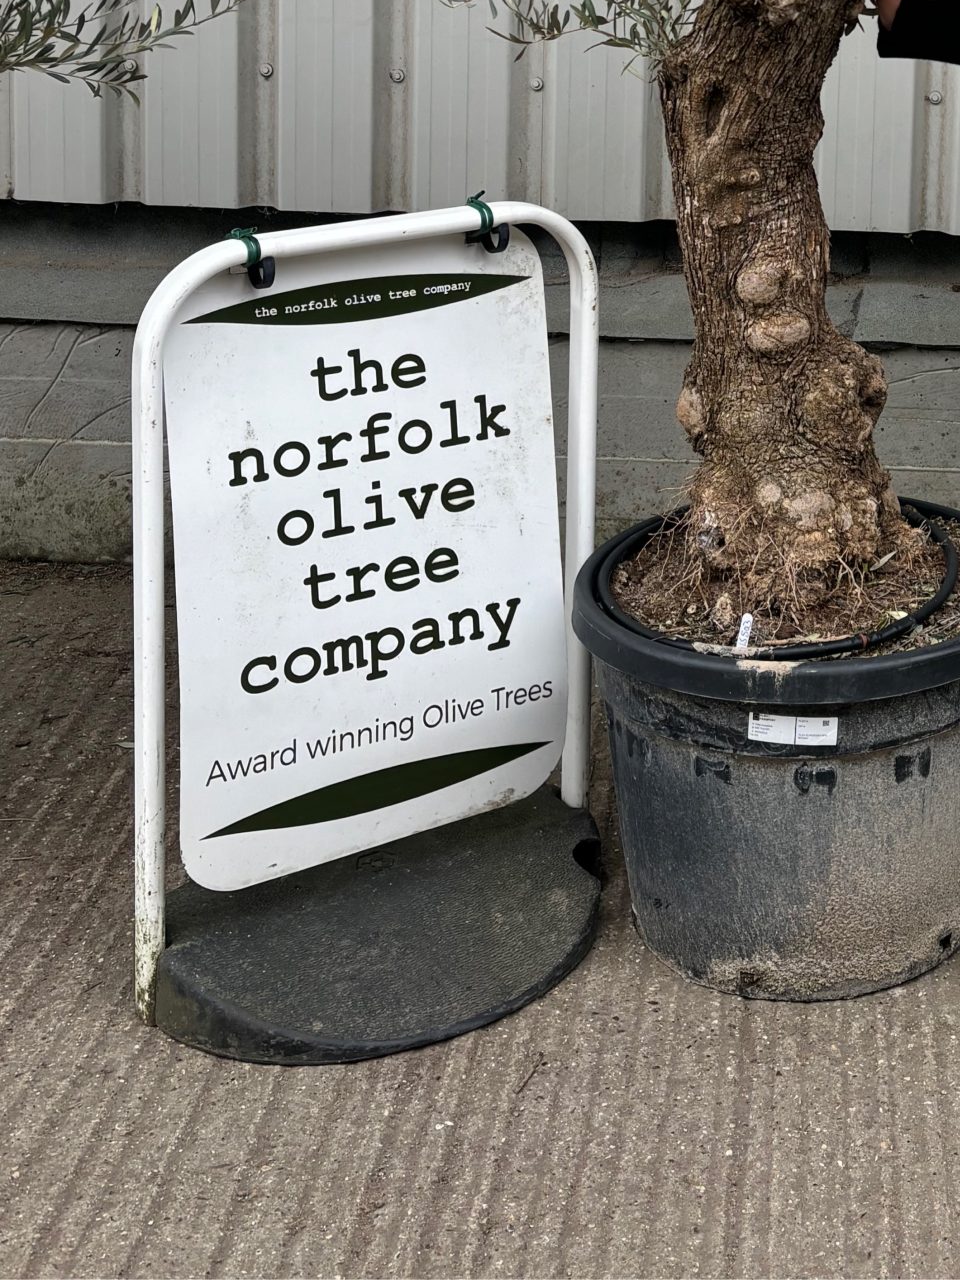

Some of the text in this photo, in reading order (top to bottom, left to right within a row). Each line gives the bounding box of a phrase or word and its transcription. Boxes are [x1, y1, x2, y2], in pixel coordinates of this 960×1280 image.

[254, 281, 472, 318] the norfolk olive tree company
[310, 348, 427, 402] the
[227, 394, 511, 487] norfolk
[276, 477, 476, 547] olive
[303, 547, 460, 610] tree
[240, 597, 522, 695] company
[205, 680, 554, 787] Award winning Olive Trees
